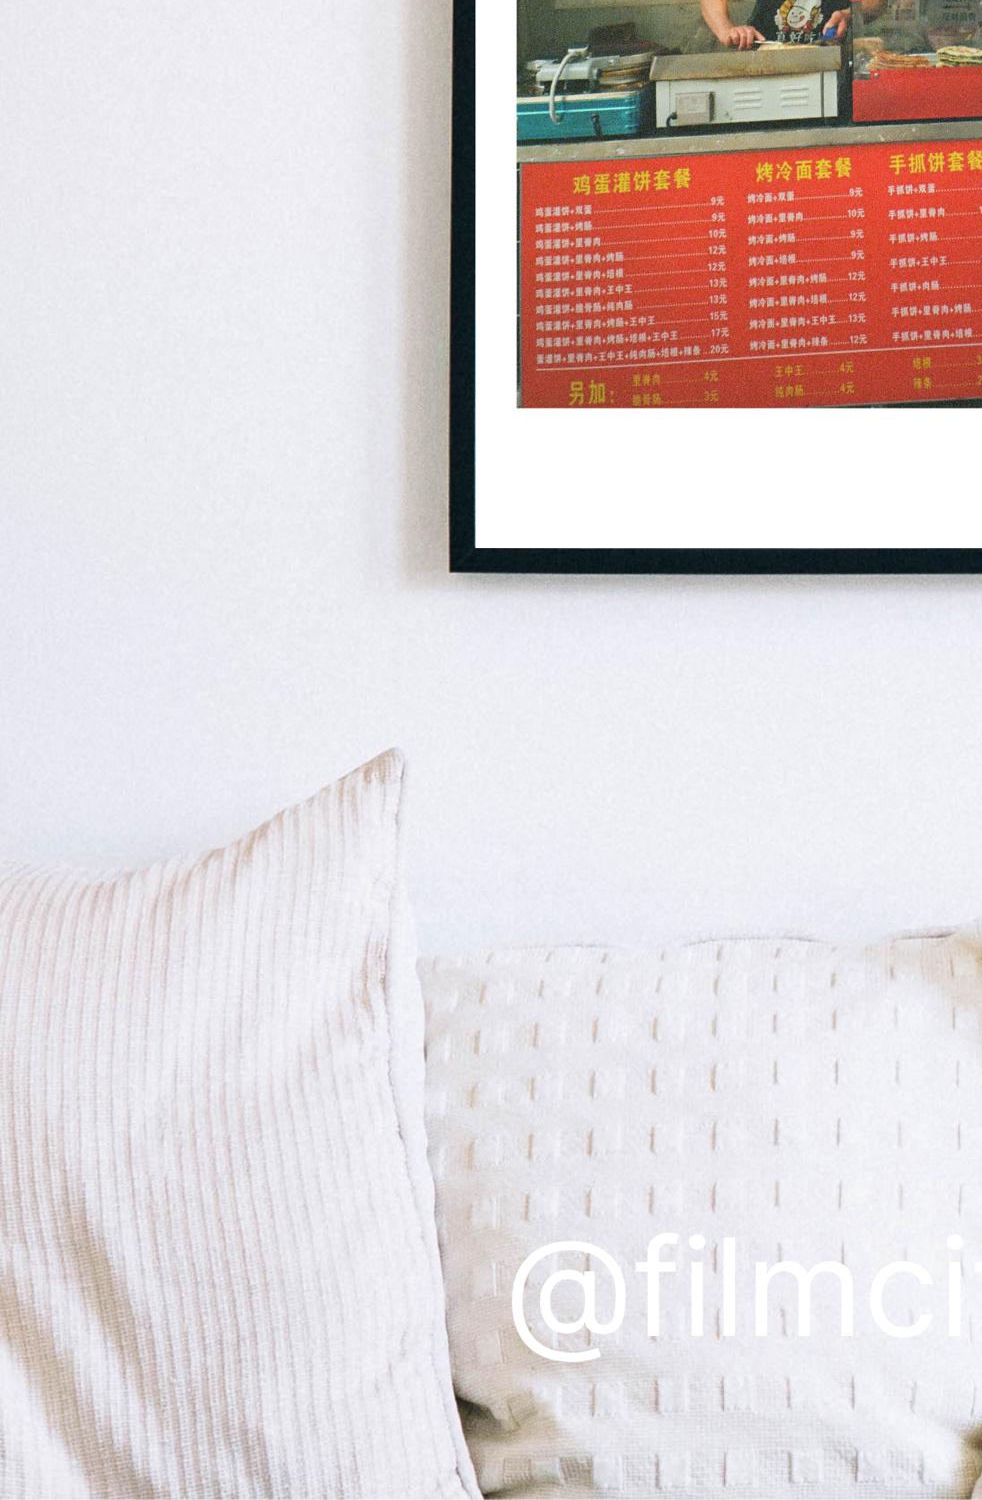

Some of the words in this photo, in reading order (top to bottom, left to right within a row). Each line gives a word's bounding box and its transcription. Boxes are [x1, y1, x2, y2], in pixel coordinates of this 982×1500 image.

[573, 168, 691, 195] 鸡蛋灌饼套餐
[756, 157, 852, 182] 烤冷面套餐
